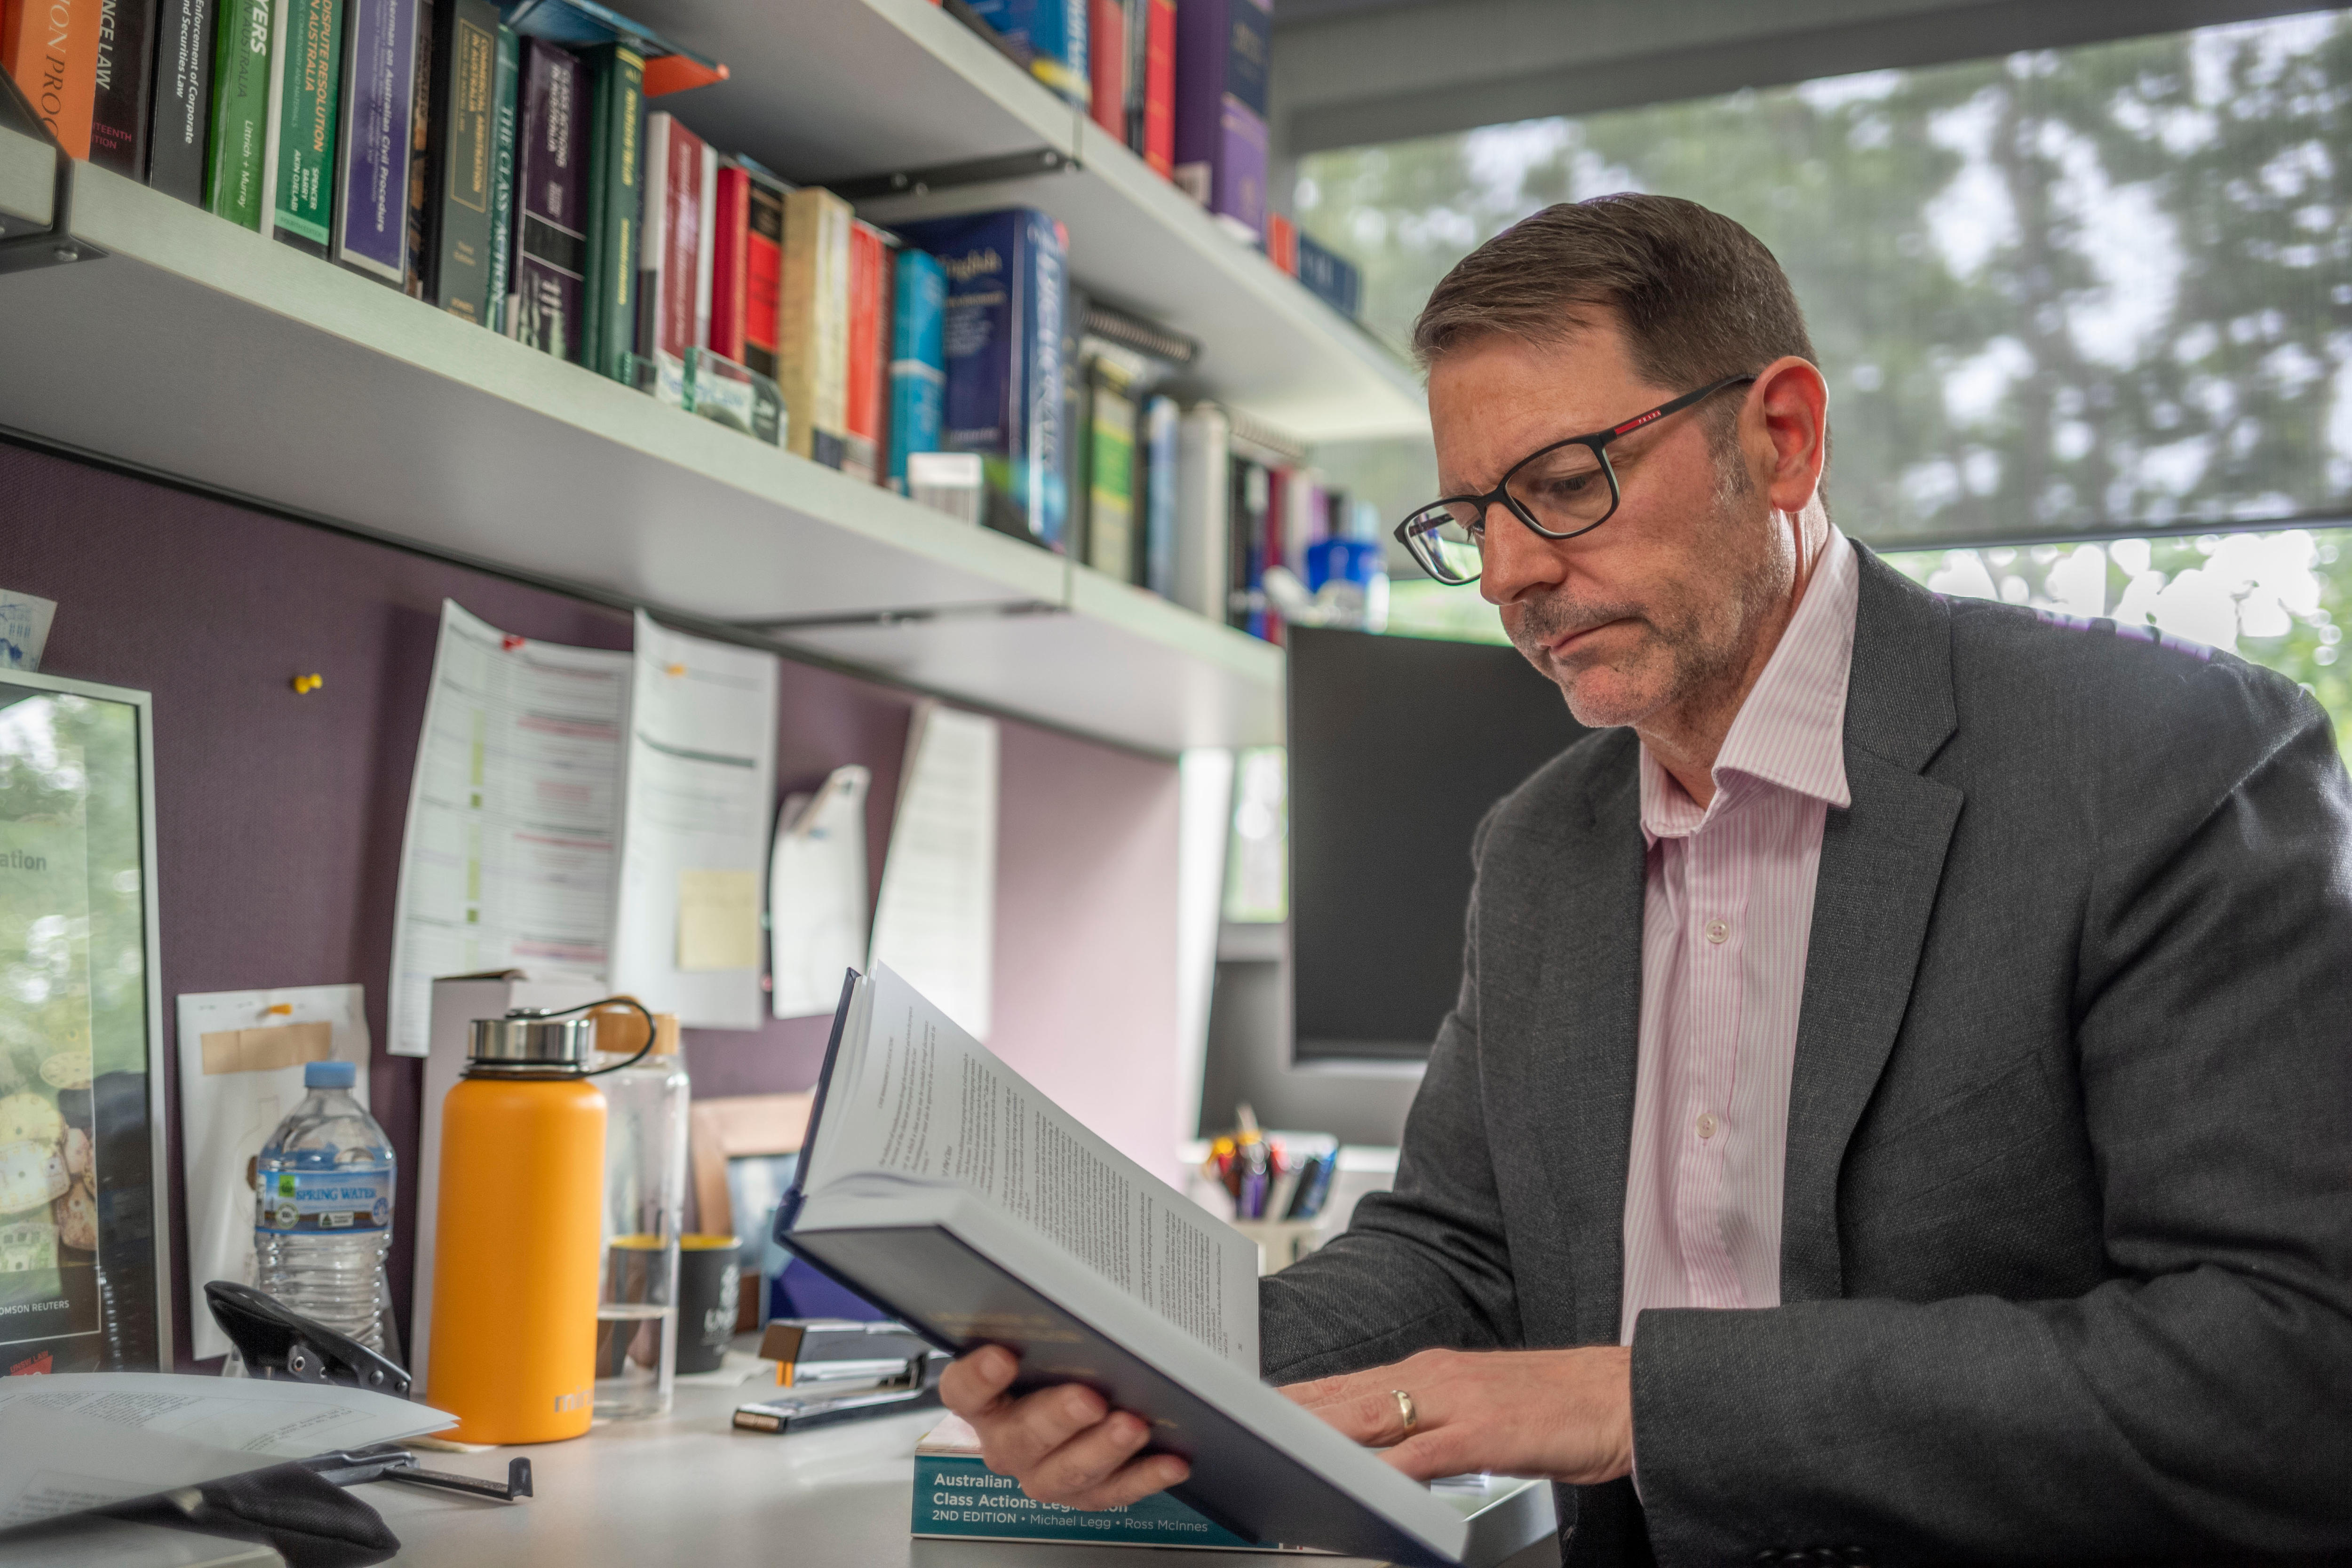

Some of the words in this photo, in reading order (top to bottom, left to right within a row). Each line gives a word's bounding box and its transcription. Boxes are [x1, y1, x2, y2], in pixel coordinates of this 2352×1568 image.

[47, 0, 70, 54] ON
[98, 0, 118, 41] NCE
[191, 0, 204, 70] Enforcement
[320, 0, 332, 56] DISPUTE
[178, 16, 191, 73] Securities
[237, 18, 251, 98] AUSTRALIA
[305, 9, 320, 91] AUSTRALIA
[386, 49, 394, 65] on
[95, 43, 113, 91] LAW
[176, 74, 187, 98] Law
[191, 71, 198, 81] of
[185, 82, 198, 144] Corporate
[313, 56, 329, 152] RESOLUTION
[381, 71, 394, 132] Australian
[243, 120, 254, 157] Littrich
[499, 104, 514, 149] THE
[380, 135, 390, 165] Civil
[237, 170, 249, 208] Murray
[290, 176, 300, 212] OJELABI
[301, 168, 310, 201] BARRY
[309, 167, 320, 210] SPENCER
[376, 166, 389, 232] Procedure
[495, 150, 512, 213] CLASS
[491, 219, 509, 304] ACTION
[1637, 410, 1661, 424] PRADA
[296, 1188, 338, 1201] SPRING
[341, 1188, 377, 1200] WATER
[32, 1300, 70, 1311] REUTERS
[933, 1492, 974, 1507] Class
[978, 1493, 1037, 1509] Actions
[934, 1472, 1013, 1489] Australian
[932, 1509, 960, 1521] 2ND
[963, 1511, 1016, 1524] EDITION
[1031, 1514, 1076, 1527] Michael
[1081, 1516, 1112, 1530] Legg
[1125, 1518, 1153, 1530] Ross
[1158, 1520, 1208, 1532] McInnes
